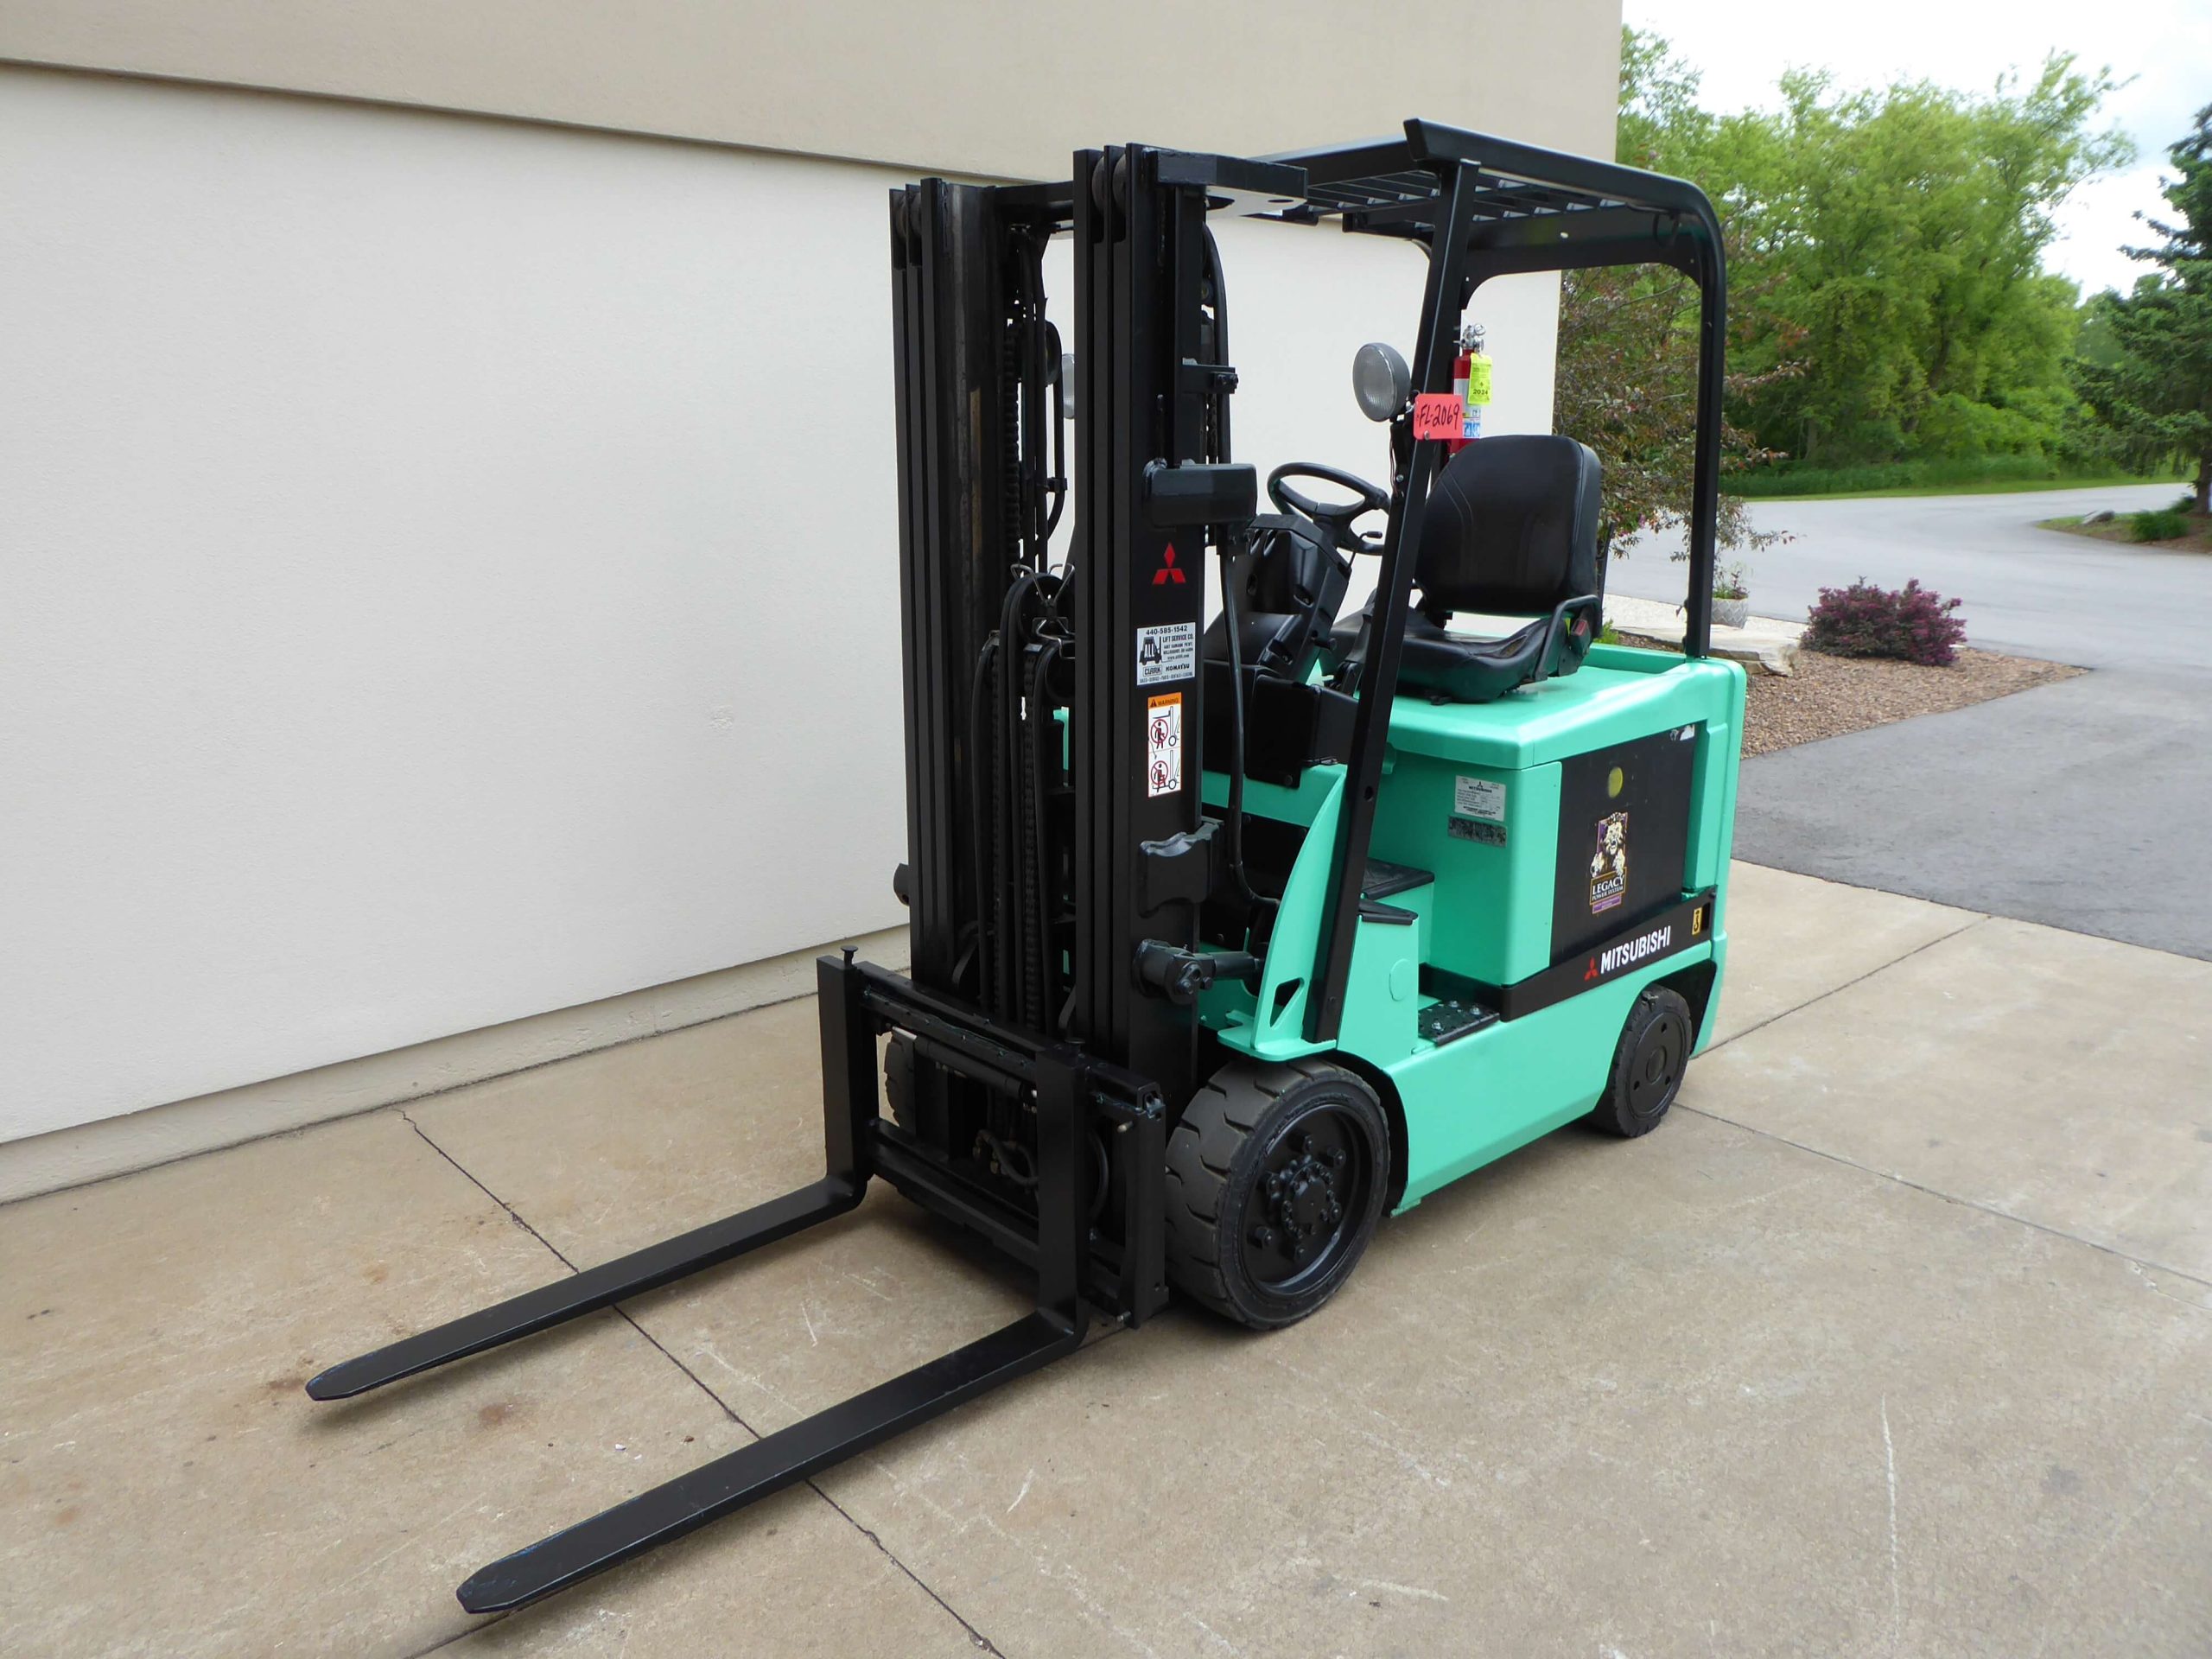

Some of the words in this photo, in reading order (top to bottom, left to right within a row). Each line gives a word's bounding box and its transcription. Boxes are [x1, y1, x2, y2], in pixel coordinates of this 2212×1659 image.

[1418, 403, 1460, 430] FL-2069
[1144, 644, 1155, 658] ALL
[1592, 874, 1624, 895] LEGACY
[1600, 925, 1671, 975] MITSUBISHI
